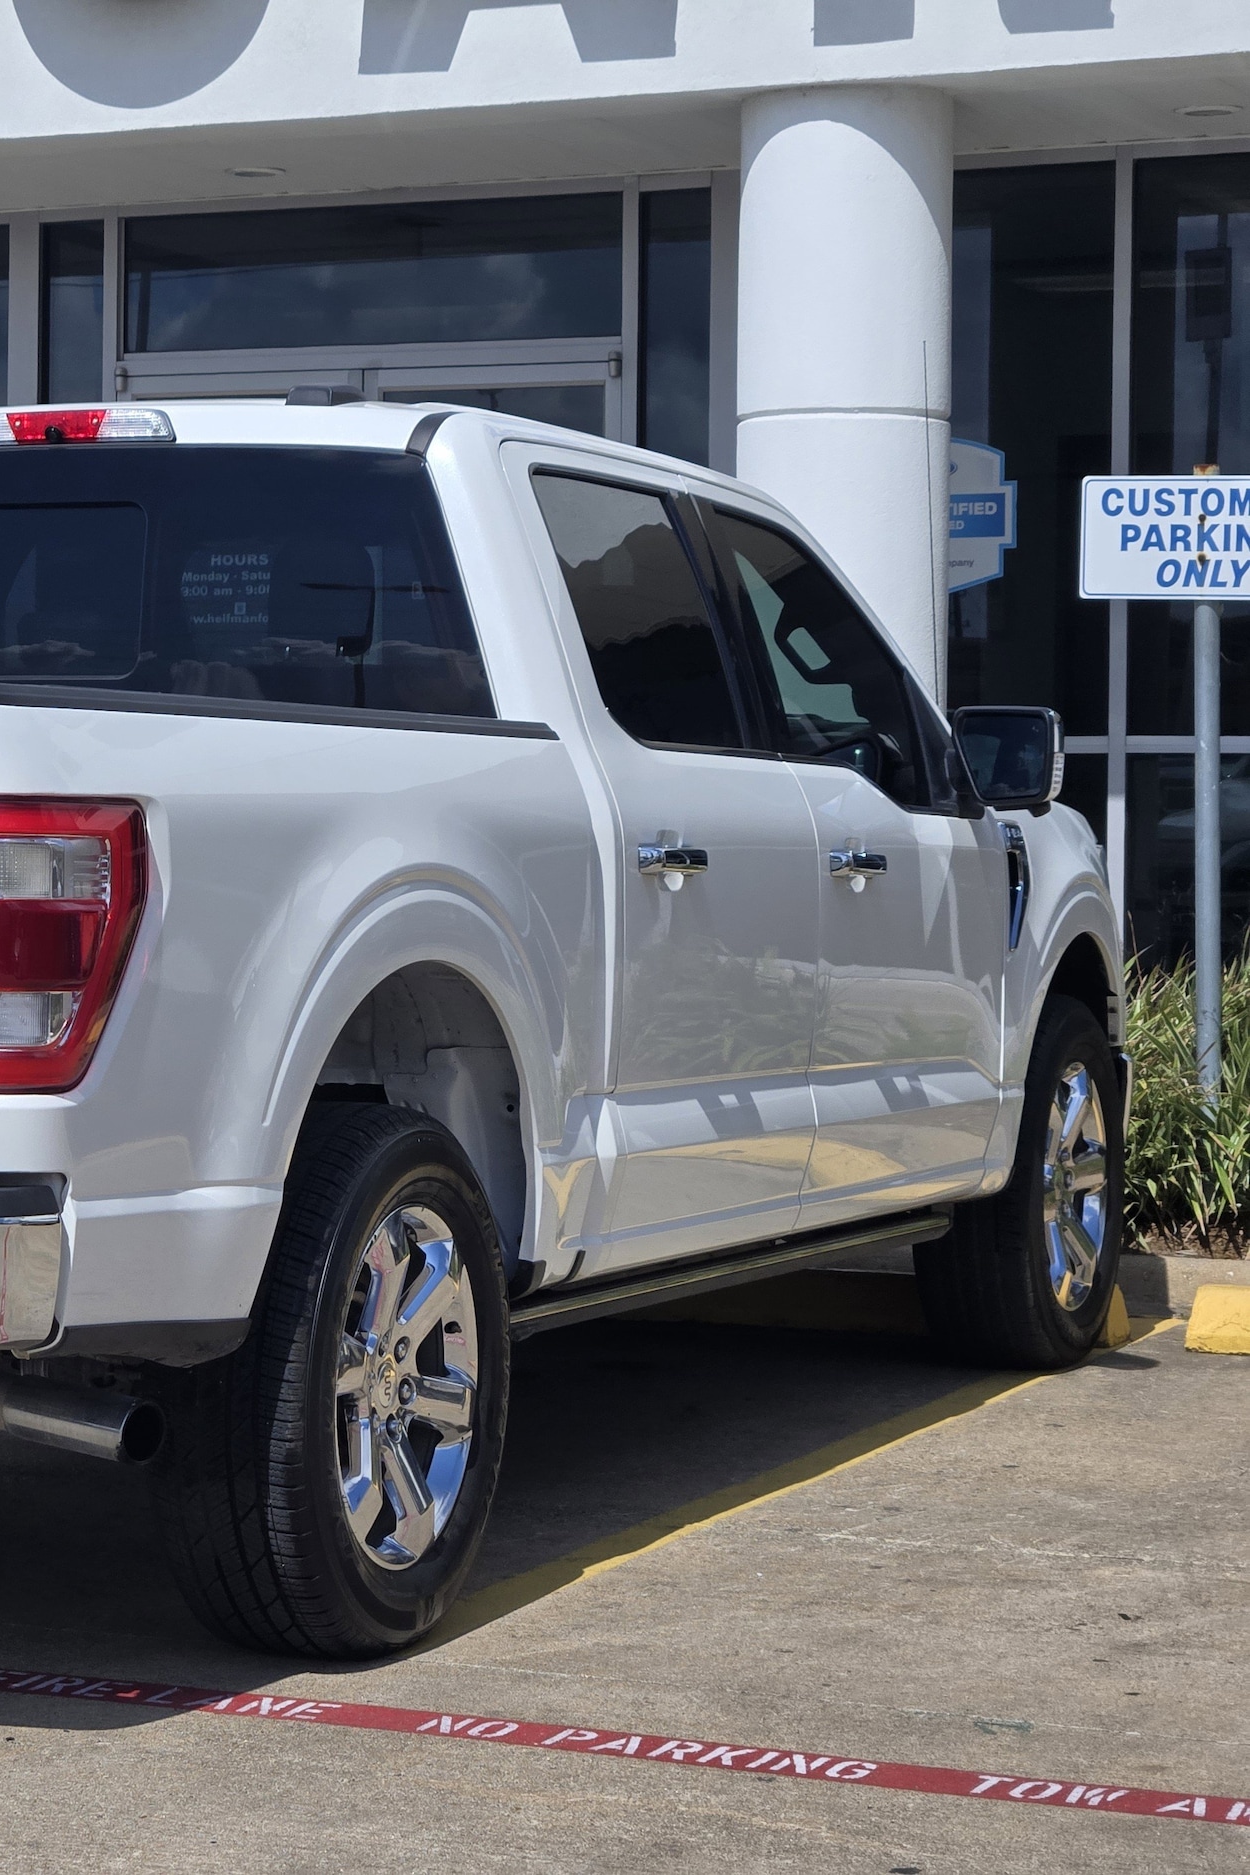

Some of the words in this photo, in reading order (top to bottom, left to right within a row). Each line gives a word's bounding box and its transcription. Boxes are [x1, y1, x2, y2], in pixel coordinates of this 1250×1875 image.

[1101, 487, 1250, 517] CUSTOM
[1120, 523, 1250, 552] PARKIN
[210, 553, 269, 567] HOURS
[1156, 558, 1250, 588] ONLY
[181, 571, 230, 583] Monday
[241, 570, 271, 581] Satu
[213, 587, 233, 596] am
[144, 1685, 343, 1721] LANE
[416, 1714, 520, 1739] NO
[541, 1727, 878, 1780] PARKING
[968, 1774, 1130, 1807] TOW
